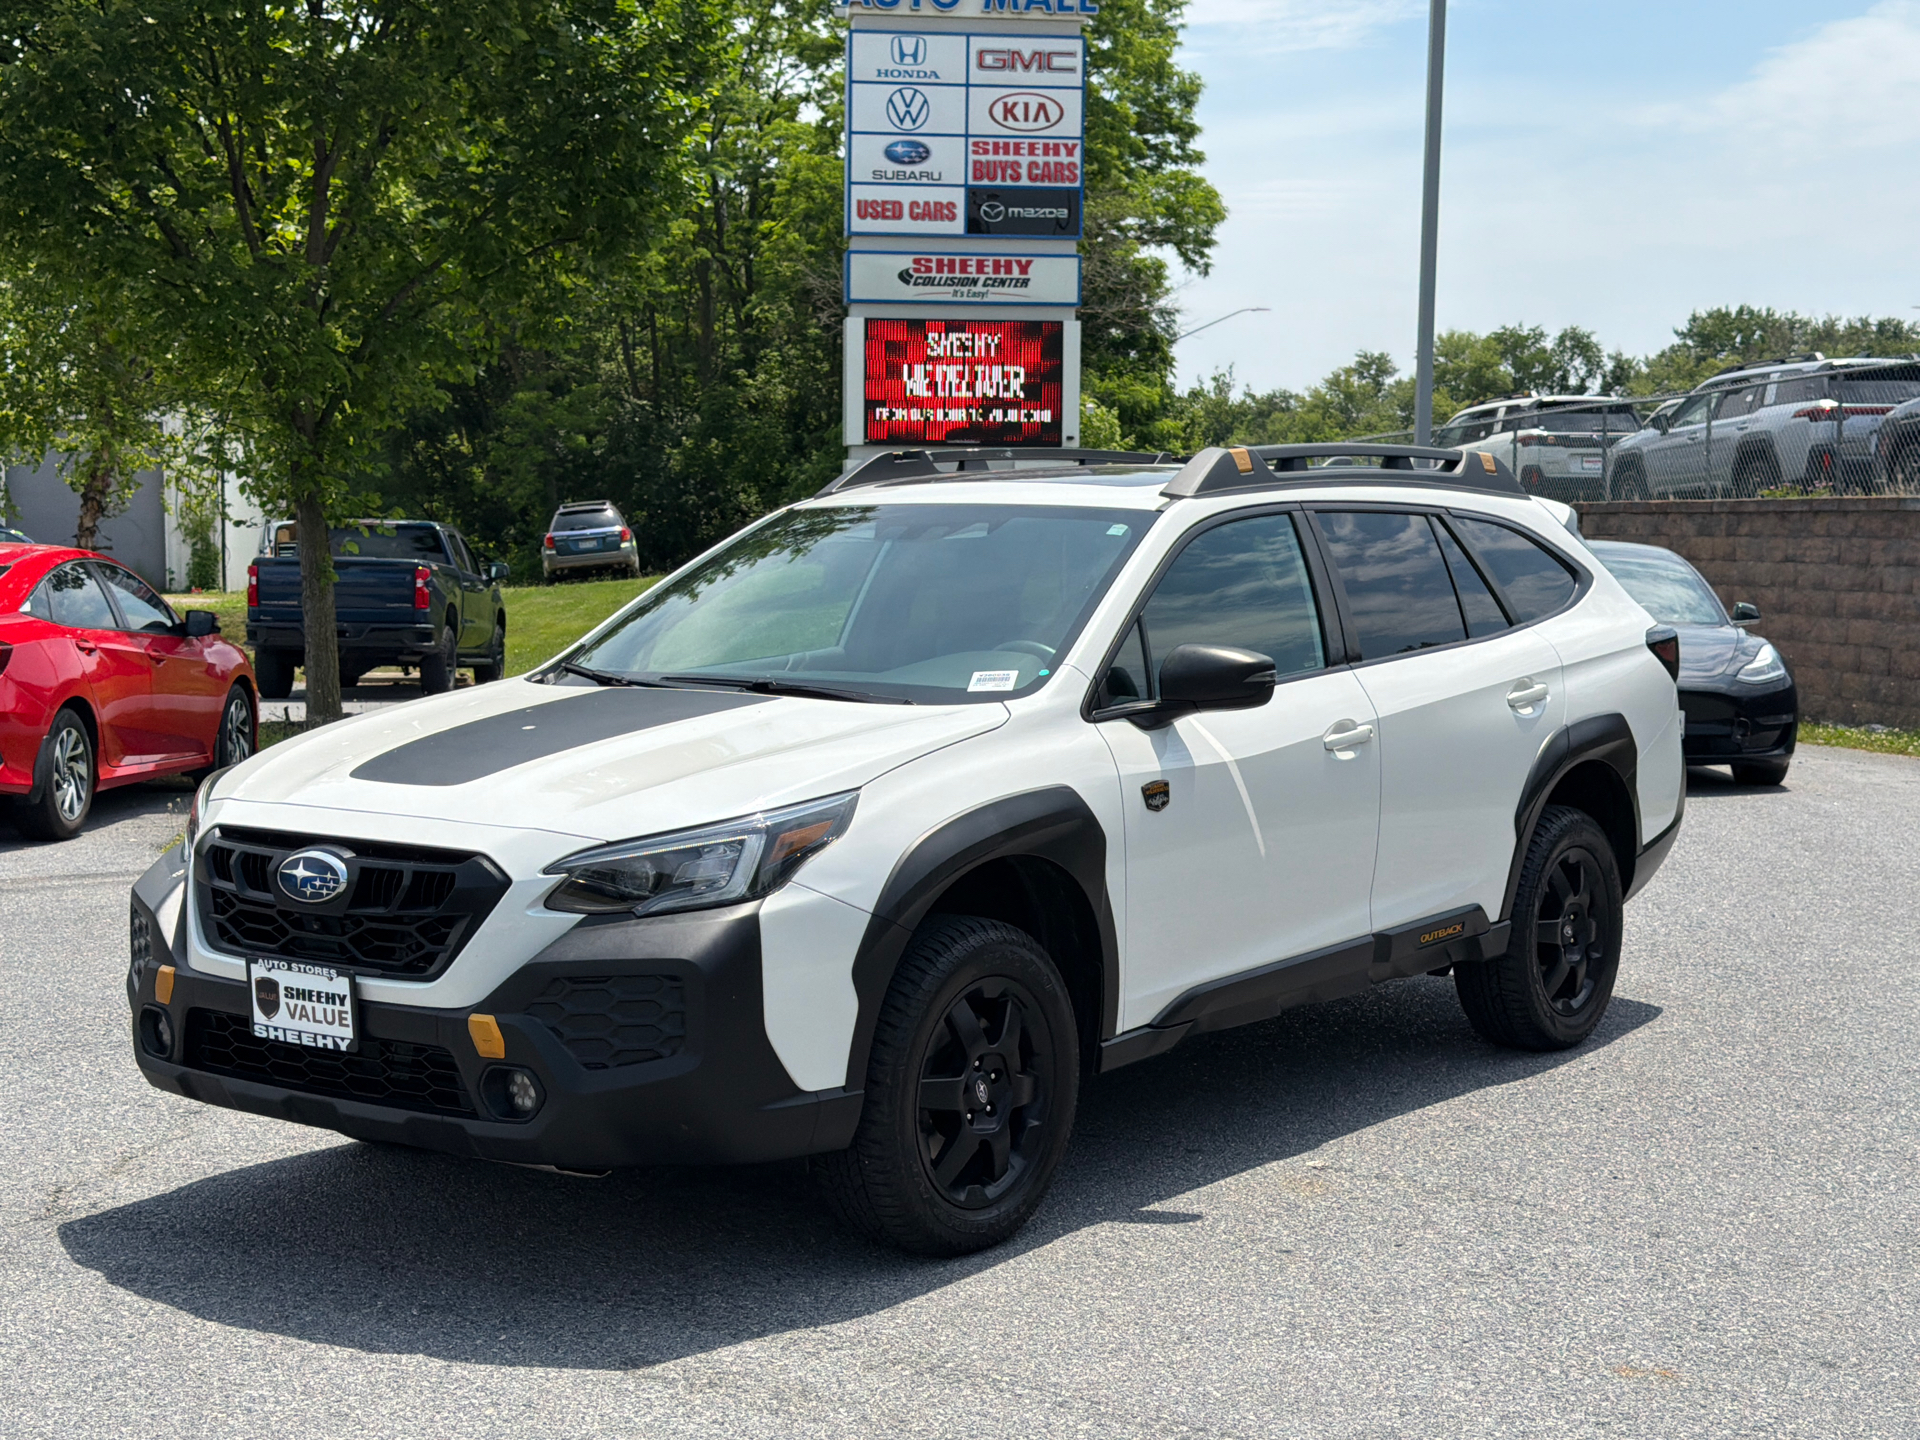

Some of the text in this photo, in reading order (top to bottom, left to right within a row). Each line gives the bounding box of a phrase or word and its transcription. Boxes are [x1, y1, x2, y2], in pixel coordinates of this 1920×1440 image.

[977, 49, 1077, 73] GMC
[876, 69, 941, 79] HONDA
[1002, 101, 1051, 123] KIA
[971, 141, 1079, 158] SHEEHY
[872, 170, 942, 181] SUBARU
[972, 160, 1079, 184] BUYS CARS
[856, 199, 957, 221] USED CARS
[912, 257, 1034, 276] SHEEHY
[912, 276, 1032, 288] COLLISION CENTER
[951, 289, 990, 299] It's Easy!
[1420, 923, 1463, 943] OUTBACK
[257, 958, 338, 978] AUTO STORES
[284, 986, 348, 1007] SHEEHY
[285, 1001, 350, 1028] VALUE
[253, 1024, 351, 1052] SHEEHY
